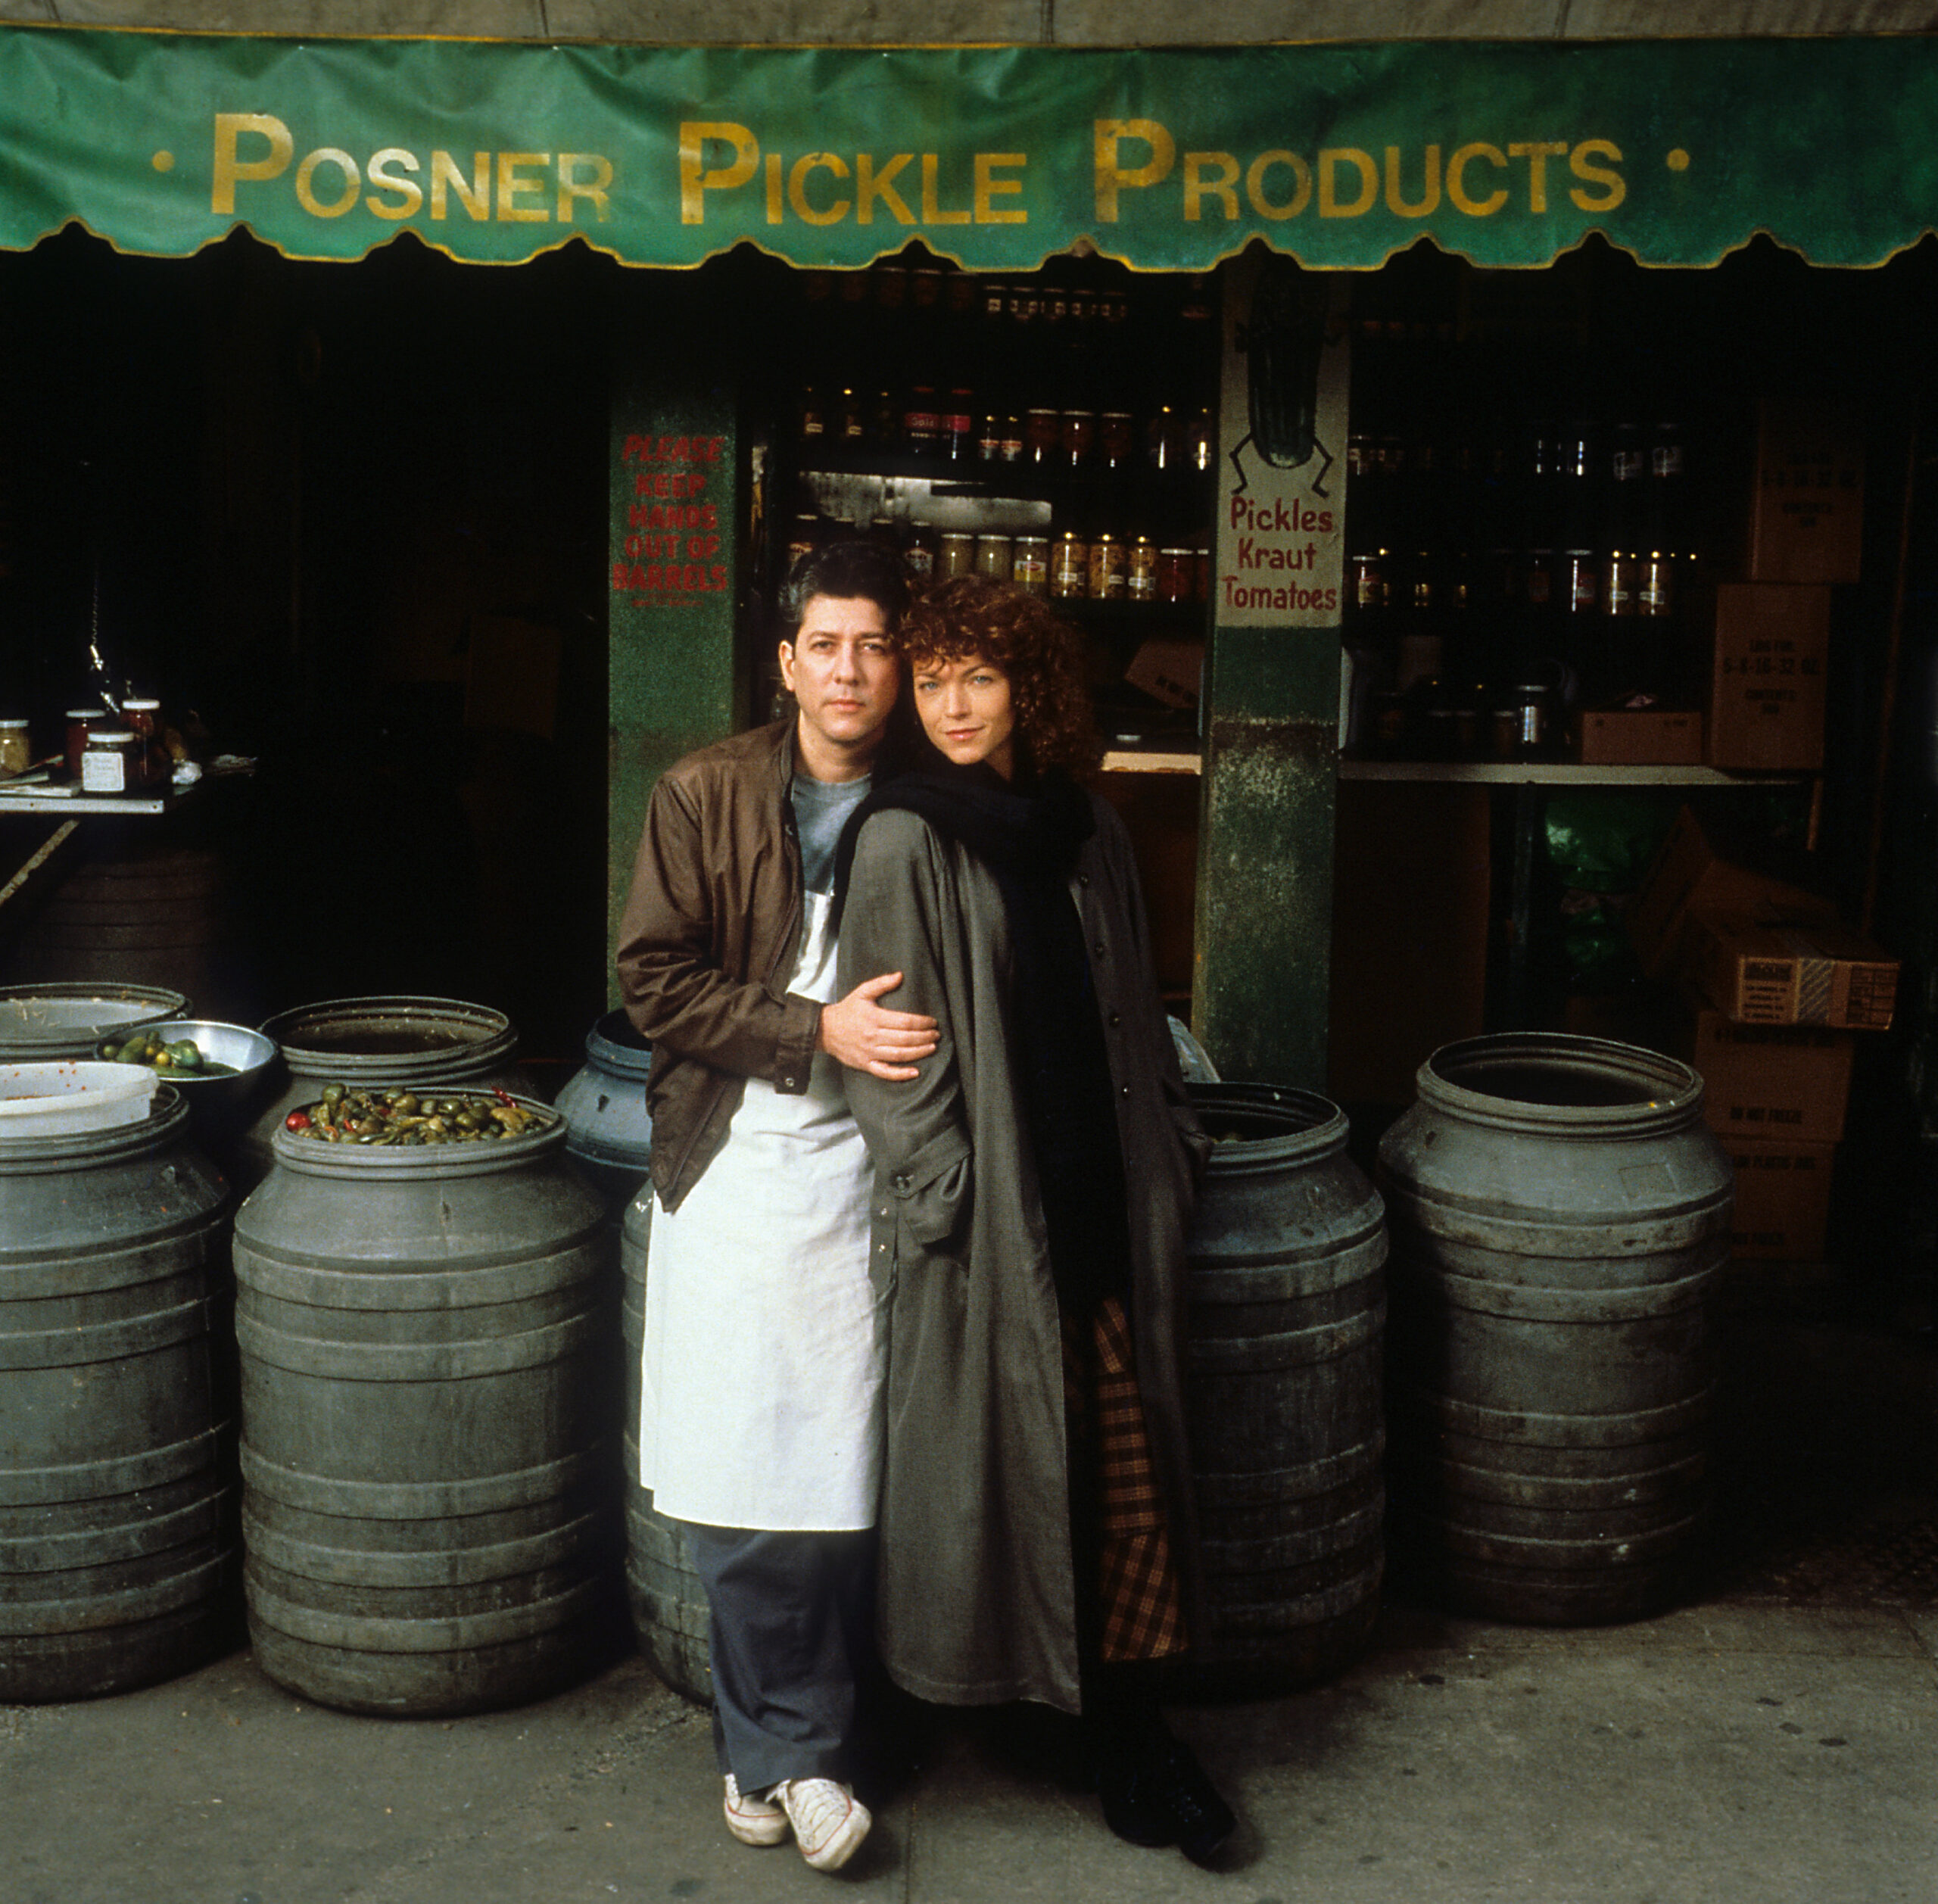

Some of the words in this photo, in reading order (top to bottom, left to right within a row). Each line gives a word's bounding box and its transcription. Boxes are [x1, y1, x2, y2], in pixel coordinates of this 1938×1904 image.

[622, 434, 726, 463] PLEASE
[636, 472, 706, 499] KEEP
[629, 504, 717, 530] HANDS
[1230, 496, 1333, 533] Pickles
[625, 534, 681, 559] OUT
[687, 534, 721, 559] OF
[1238, 537, 1316, 569] Kraut
[612, 562, 728, 592] BARRELS
[1222, 575, 1337, 611] Tomatoes
